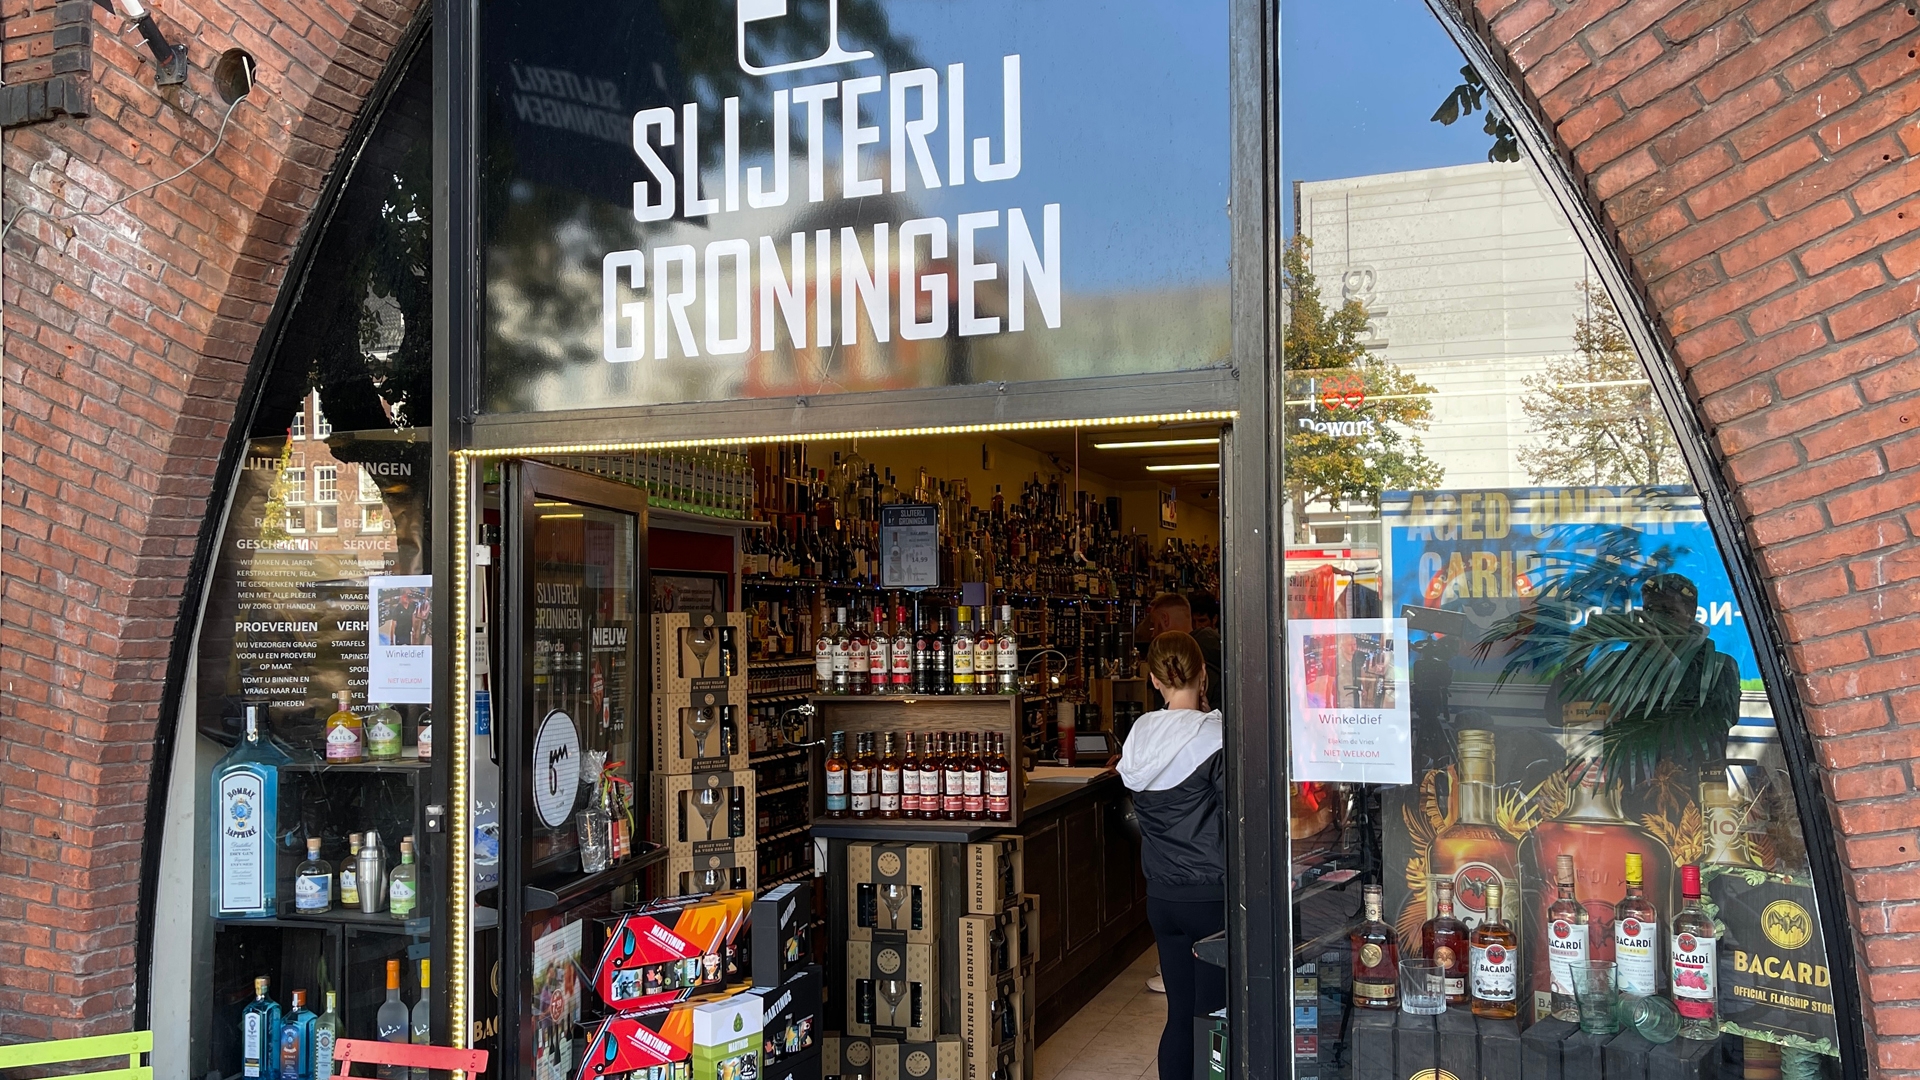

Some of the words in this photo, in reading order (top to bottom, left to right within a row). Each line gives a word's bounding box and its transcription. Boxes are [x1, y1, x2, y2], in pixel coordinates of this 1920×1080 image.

[633, 54, 1020, 223] SLIJTERIJ
[603, 203, 1060, 363] GRONINGEN
[242, 457, 304, 472] LIJTERIJ
[311, 460, 411, 476] GRONINGEN
[900, 509, 926, 517] SLIJTERIJ
[1407, 492, 1511, 541] AGED
[1530, 486, 1675, 539] UNDER
[236, 539, 318, 550] GESCHN
[343, 540, 391, 550] SERVICE
[536, 583, 579, 604] SLIJTERIJ
[235, 622, 318, 632] PROEVERIJEN
[337, 621, 369, 631] VERH
[592, 627, 628, 646] NIEUW
[386, 650, 425, 659] Winkeldief
[1319, 714, 1383, 725] Winkeldief
[1323, 749, 1341, 757] NIET
[1342, 750, 1380, 758] WELKOM
[227, 787, 256, 800] BOMBAY
[225, 826, 257, 839] SAPPHIRE
[975, 846, 983, 911] GRONINGEN
[780, 897, 796, 930] MARTINUS
[650, 924, 687, 952] MARTINUS
[1548, 937, 1582, 950] BACARDÍ
[1615, 935, 1652, 948] BACARDÍ
[966, 921, 974, 987] GRONINGEN
[1672, 951, 1709, 964] BACARDÍ
[1480, 964, 1512, 973] BACARDÍ
[1733, 950, 1831, 988] BACARD
[1455, 980, 1463, 988] 8
[1383, 987, 1394, 995] 10
[1733, 985, 1768, 1002] OFFICIAL
[1770, 992, 1809, 1010] FLAGSHIP
[763, 989, 792, 1027] MARTINUS
[634, 1027, 672, 1056] MARTINUS
[728, 1038, 749, 1053] MARTINUS
